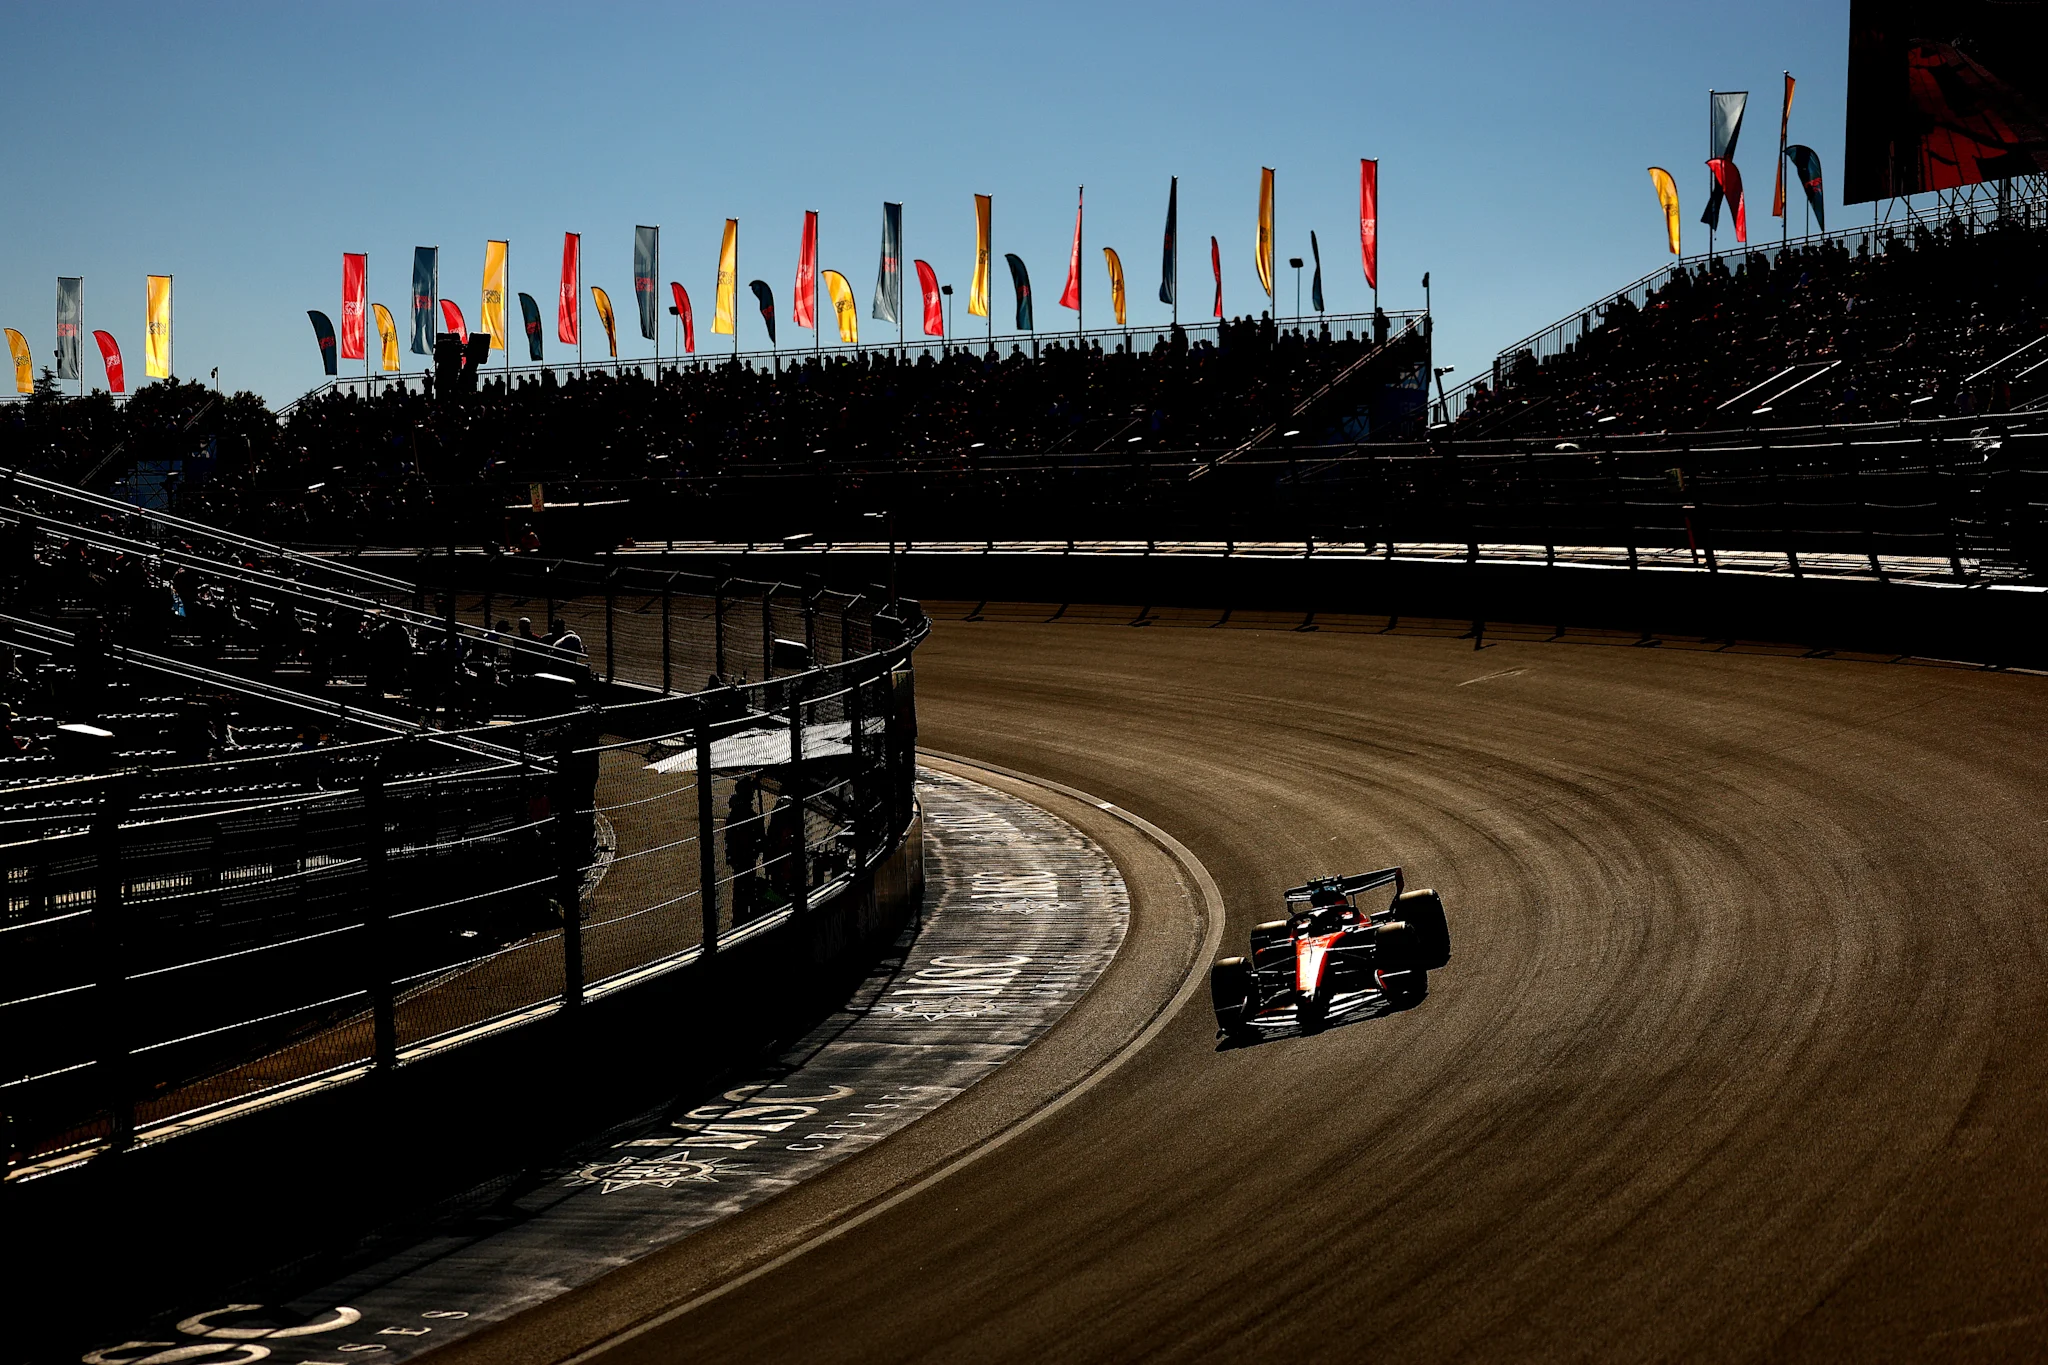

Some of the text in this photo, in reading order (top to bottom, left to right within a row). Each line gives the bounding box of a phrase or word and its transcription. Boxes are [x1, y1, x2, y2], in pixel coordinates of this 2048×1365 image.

[971, 871, 1058, 899] MSC
[891, 955, 1034, 996] MSC
[609, 1084, 855, 1150] MSC
[81, 1304, 362, 1365] SC
